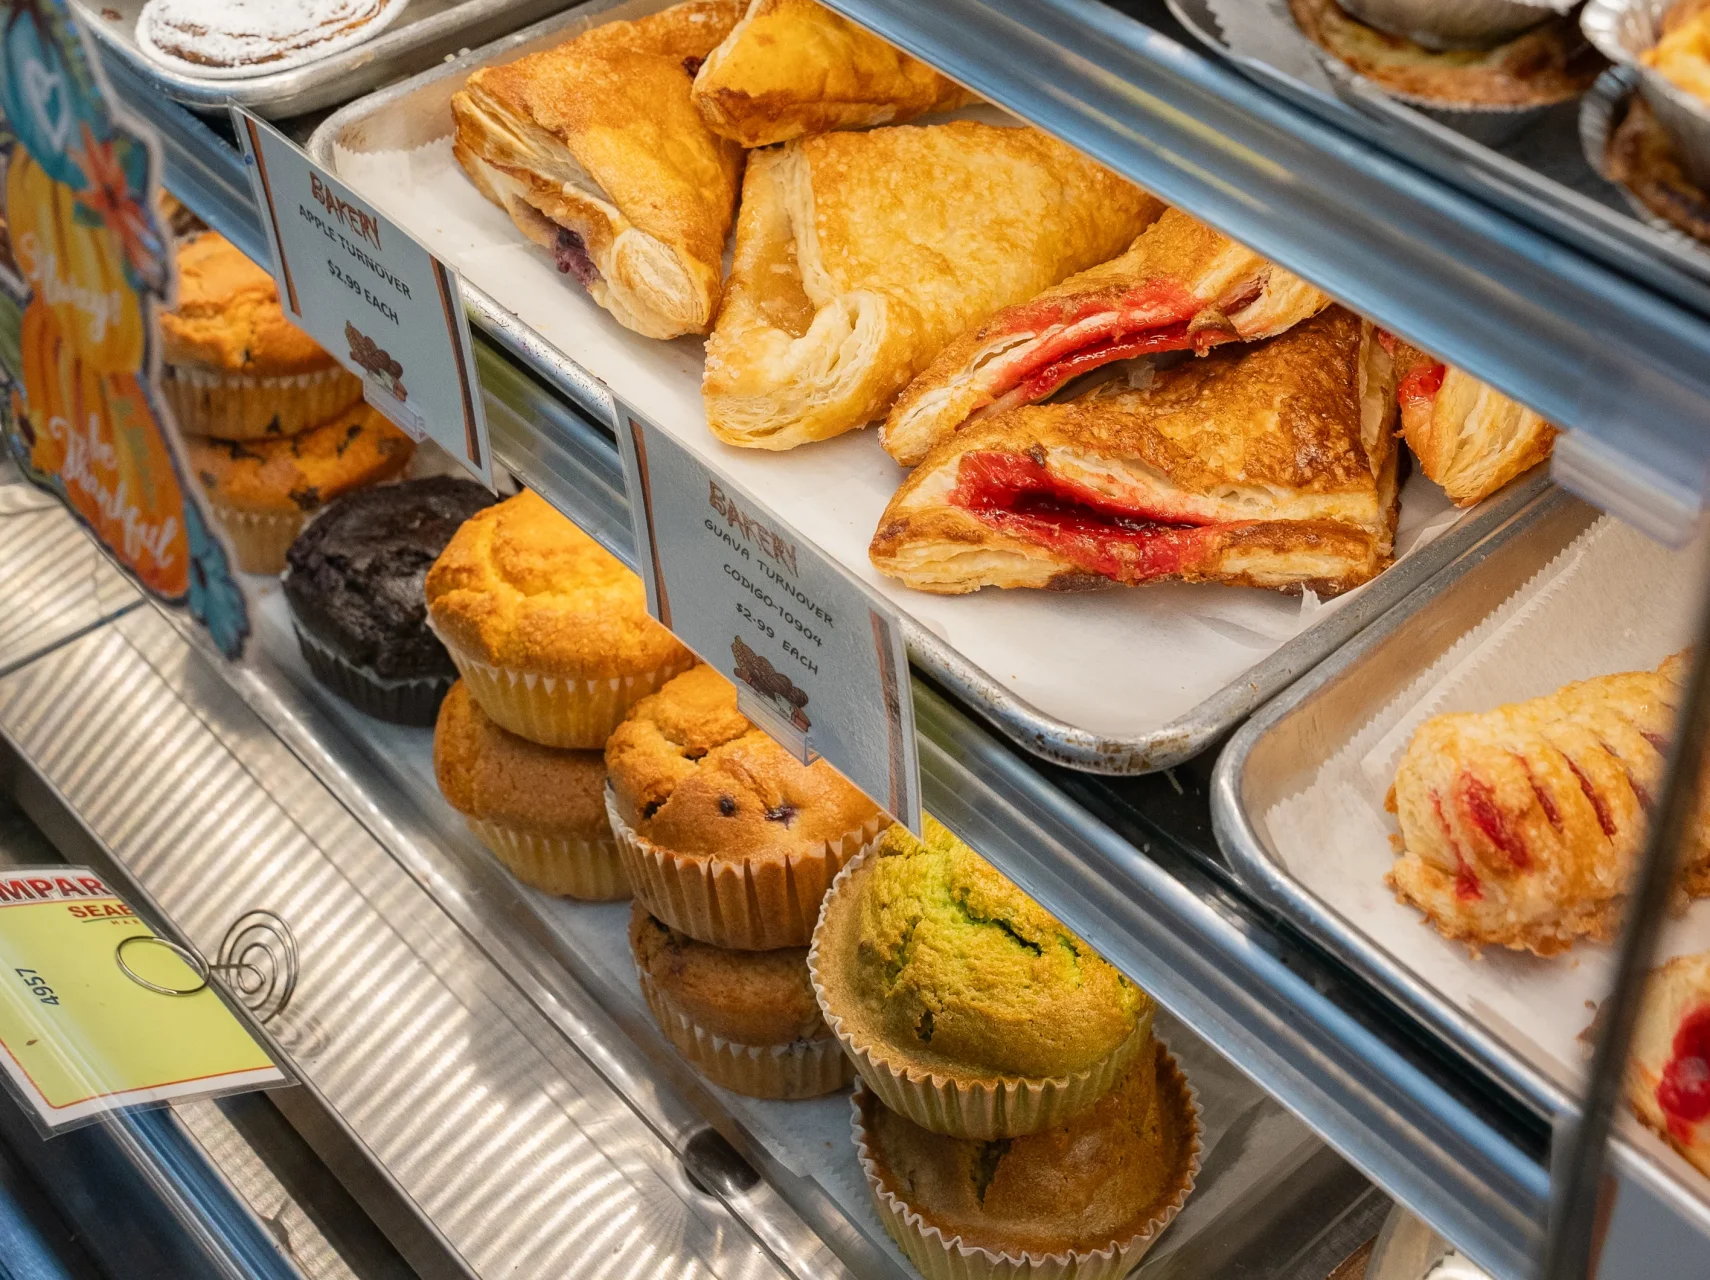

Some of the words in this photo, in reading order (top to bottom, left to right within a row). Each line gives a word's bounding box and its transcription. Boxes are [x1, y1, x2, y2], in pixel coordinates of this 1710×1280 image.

[299, 204, 337, 242] APPLE
[338, 233, 412, 300] TURNOVER
[309, 171, 382, 251] BAKERY
[327, 259, 362, 295] $2.99
[364, 288, 399, 325] EACH
[709, 480, 799, 578] BAKERY
[704, 519, 750, 560] GUAVA
[757, 560, 834, 628] TURNOVER
[723, 563, 823, 648] CODIGO-10904
[782, 640, 819, 676] EACH
[15, 968, 60, 1006] 4957
